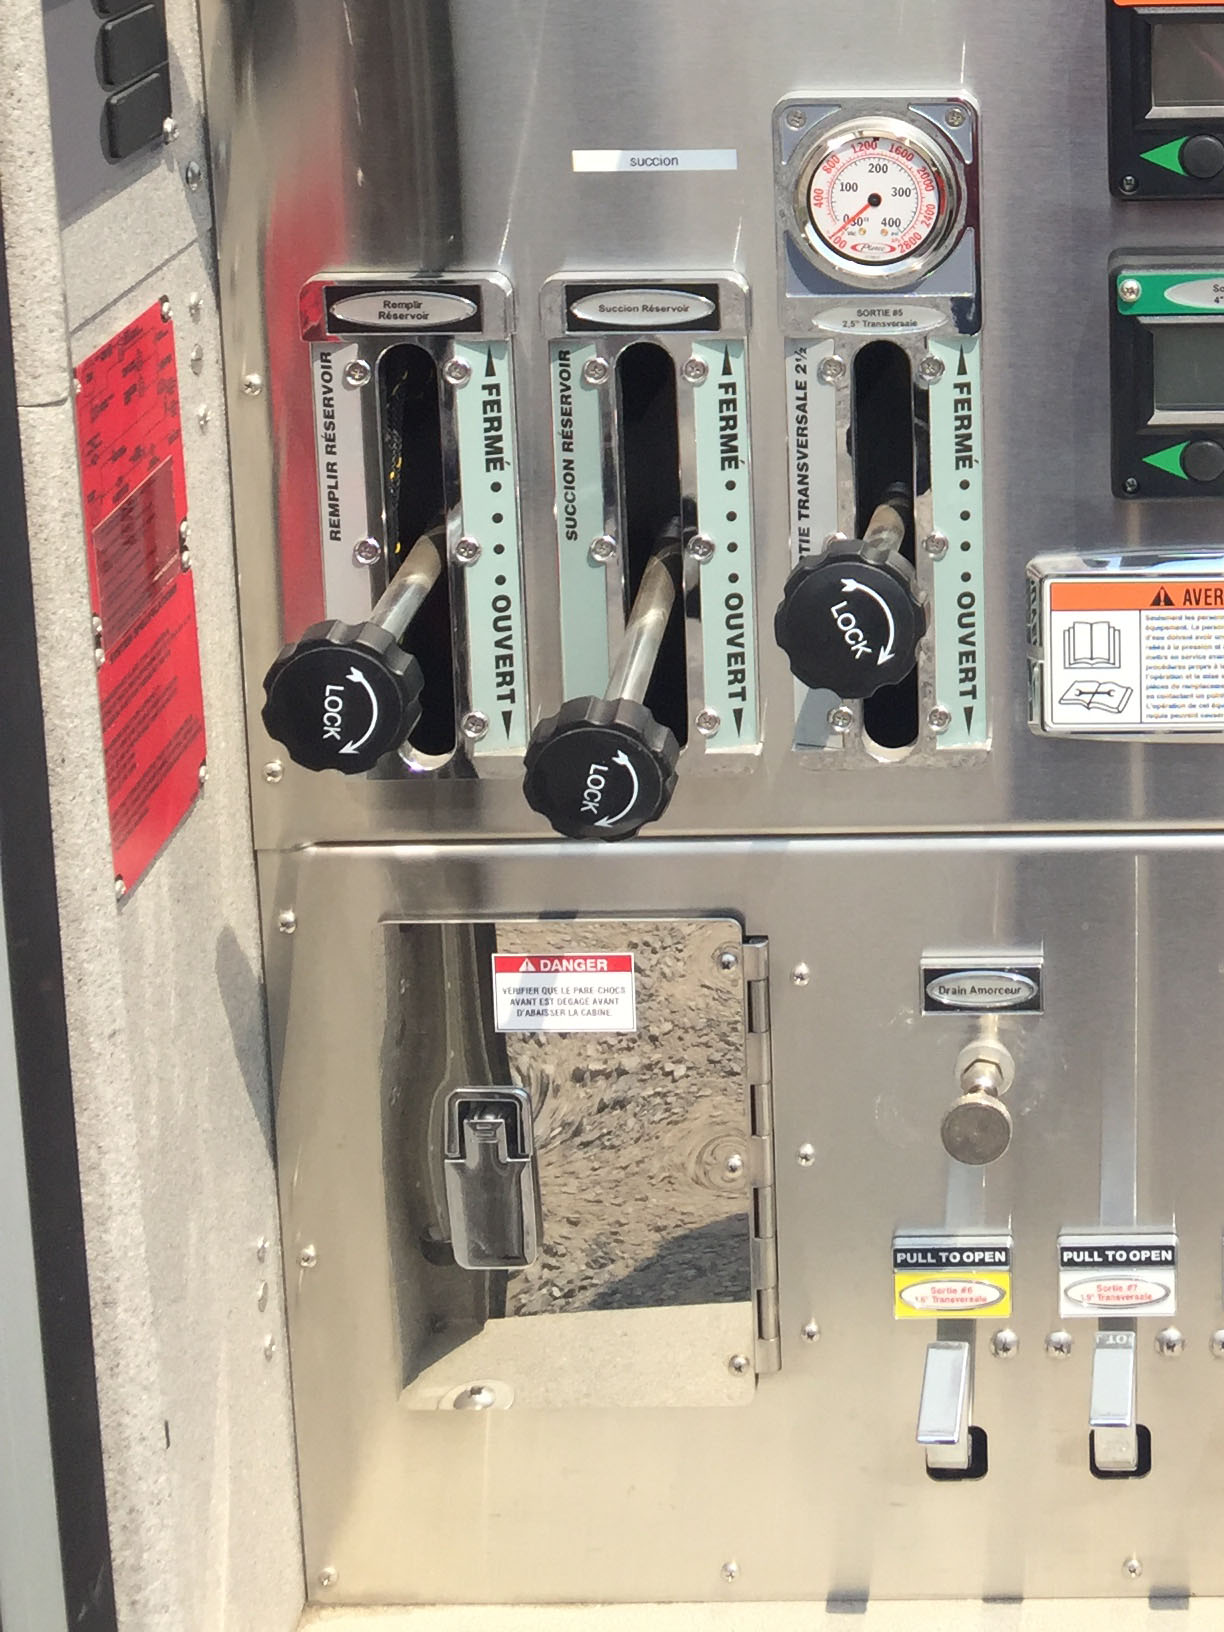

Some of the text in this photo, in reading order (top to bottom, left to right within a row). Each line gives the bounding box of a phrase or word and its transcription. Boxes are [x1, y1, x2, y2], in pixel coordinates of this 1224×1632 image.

[630, 155, 678, 167] succion
[378, 311, 428, 321] Réservoir
[383, 300, 422, 311] Remplir
[599, 304, 689, 313] Succion Réservoir
[318, 351, 342, 542] REMPLIR RÉSERVOIR
[481, 383, 511, 473] FERMÉ
[558, 350, 578, 542] SUCCION RÉSERVOIR
[718, 382, 746, 471] FERMÉ
[795, 380, 809, 519] TRANSVERSALE
[953, 382, 980, 470] FERMÉ
[492, 594, 515, 704] OUVERT
[725, 593, 746, 702] OUVERT
[830, 601, 872, 659] LOCK
[957, 592, 976, 700] OUVERT
[323, 685, 344, 740] LOCK
[580, 763, 608, 815] LOCK
[540, 960, 608, 972] DANGER
[939, 986, 1021, 995] Drain Amorceur
[897, 1251, 1005, 1263] PULL TO OPEN
[1063, 1250, 1172, 1261] PULL TO OPEN
